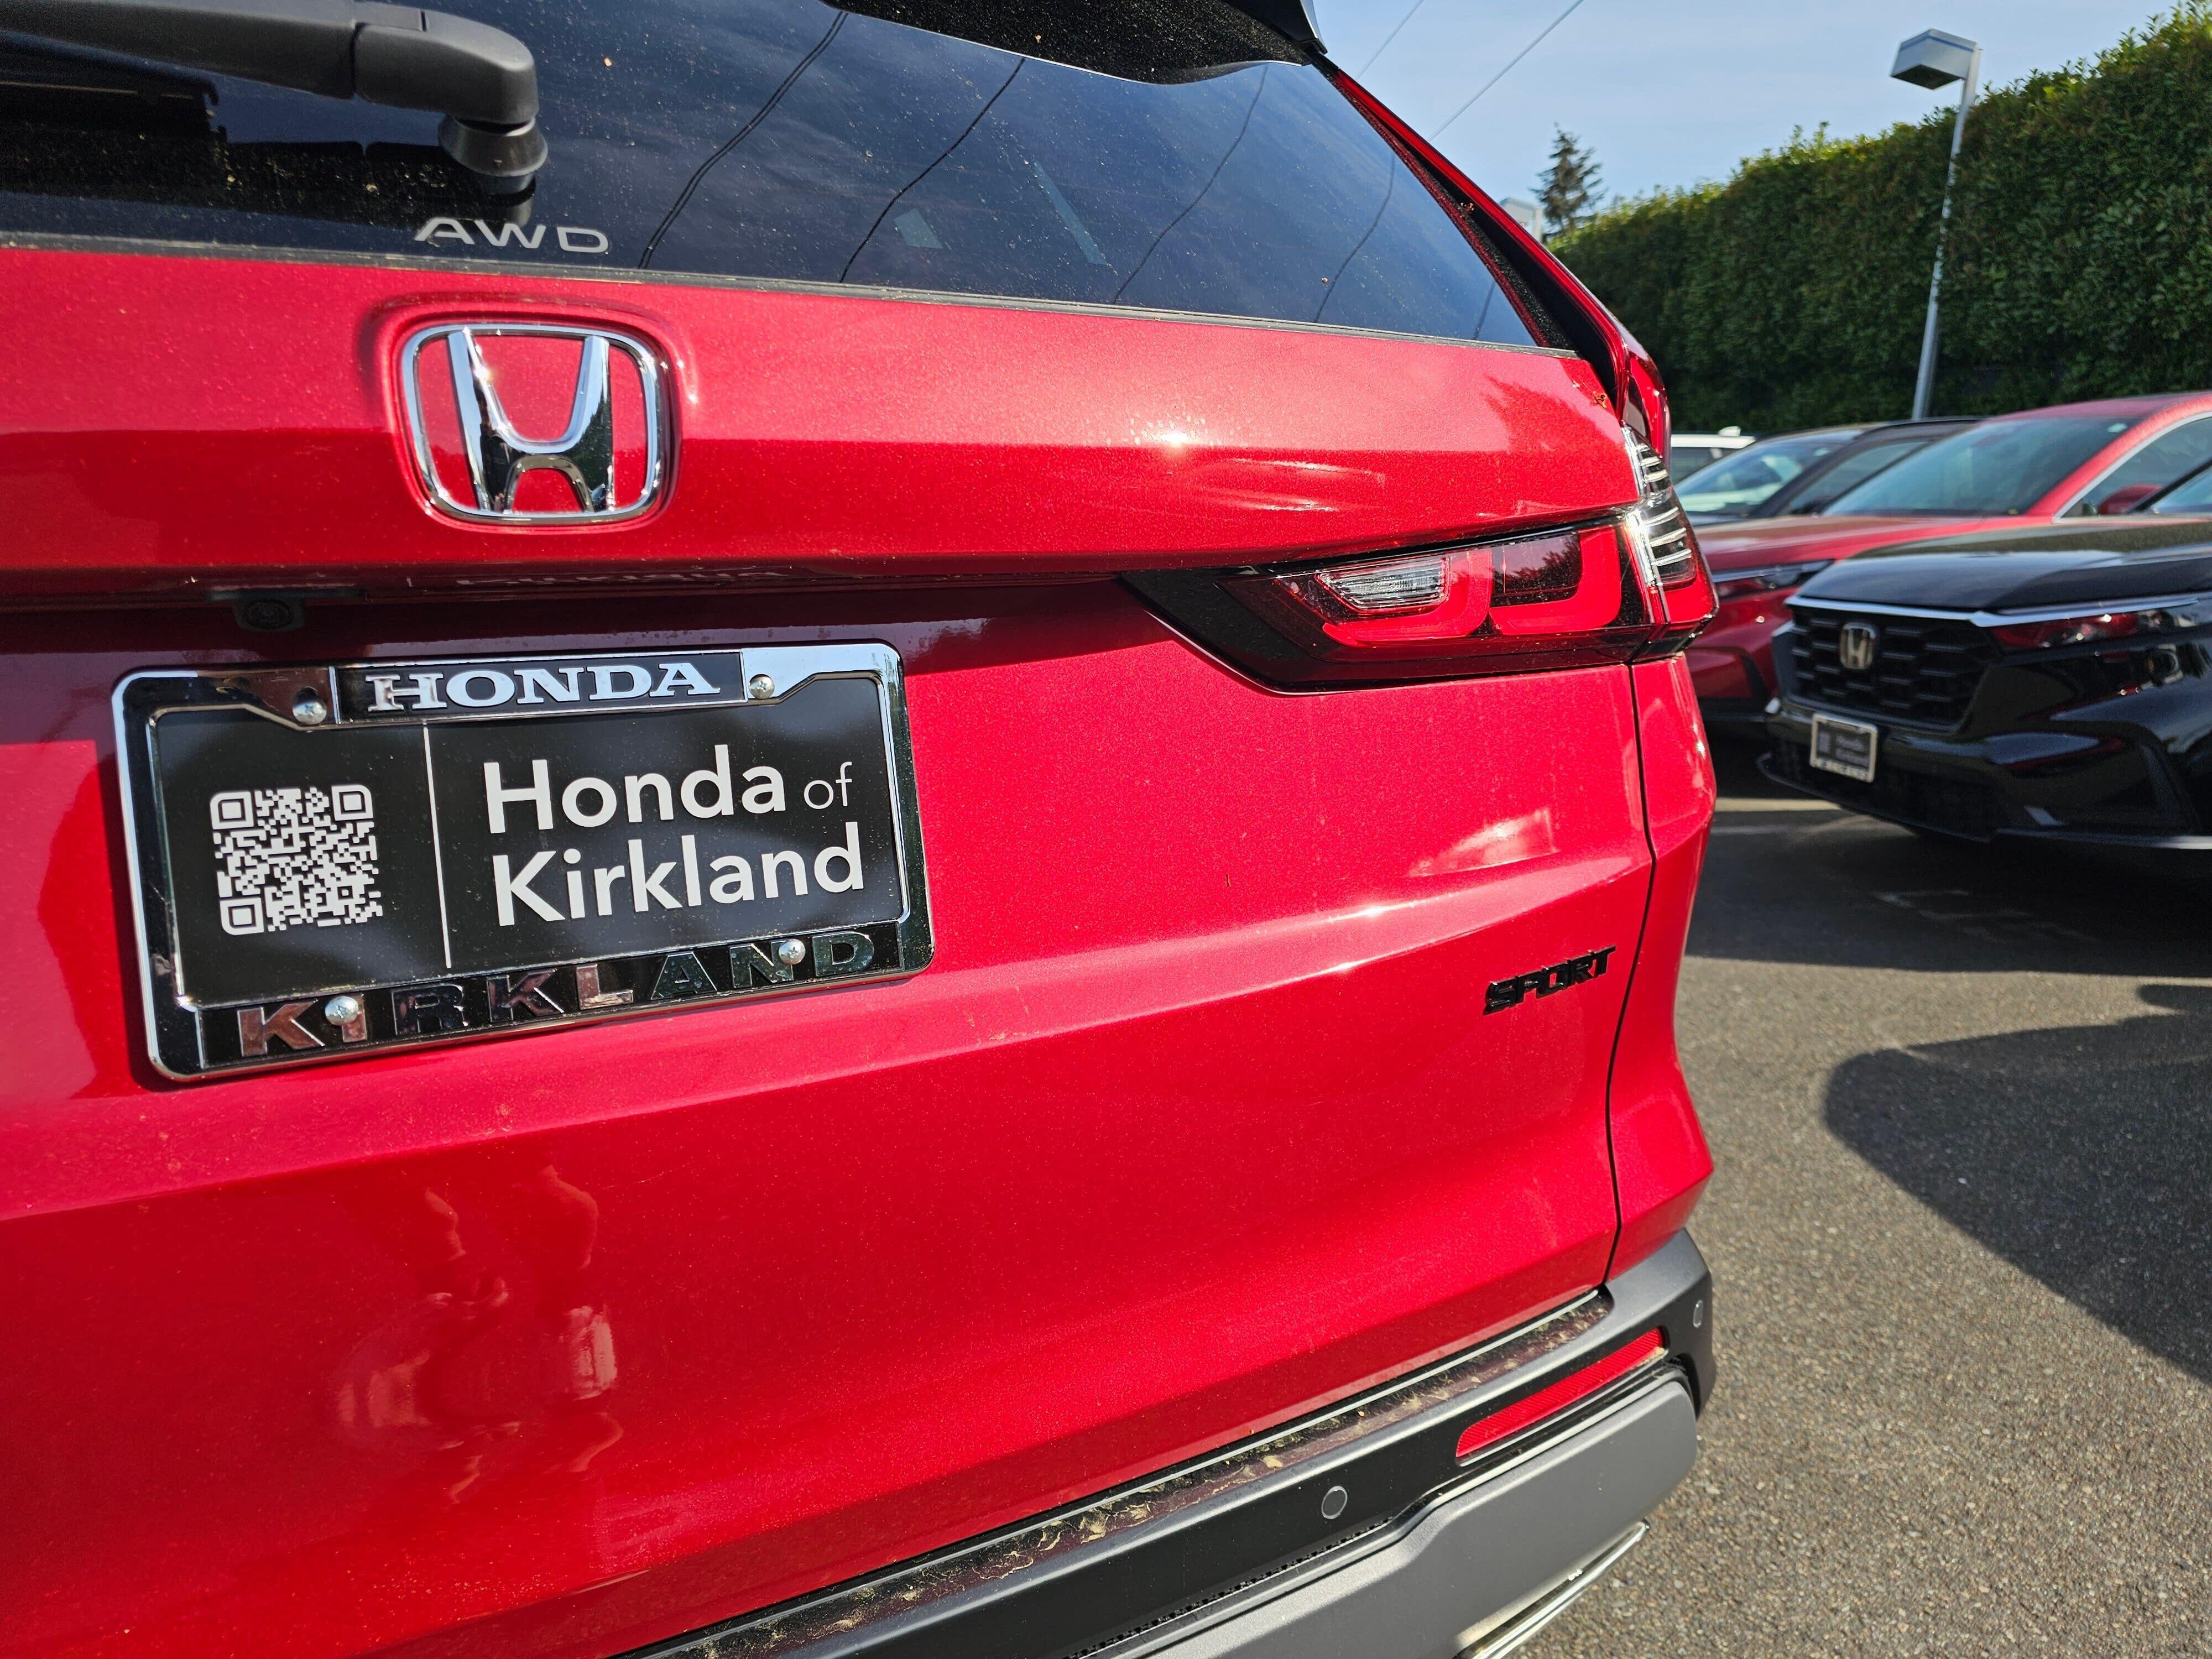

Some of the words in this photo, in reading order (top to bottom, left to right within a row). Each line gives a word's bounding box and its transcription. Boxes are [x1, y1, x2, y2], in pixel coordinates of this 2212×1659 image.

[414, 216, 609, 253] AWD
[365, 662, 721, 712] HONDA
[483, 744, 786, 834] Honda
[803, 761, 853, 810] of
[492, 821, 864, 927] Kirkland
[1482, 944, 1616, 1016] SPORT
